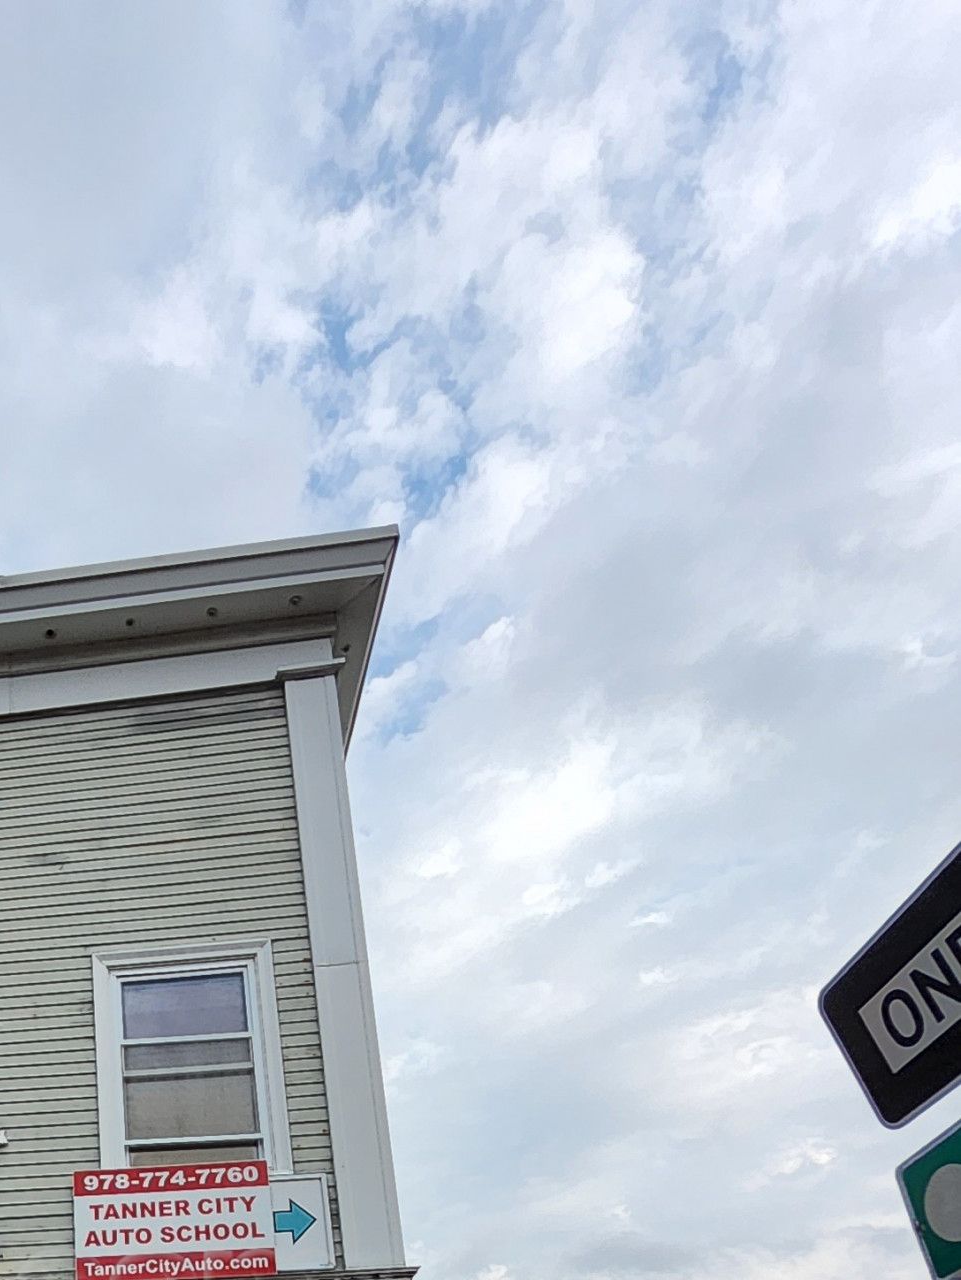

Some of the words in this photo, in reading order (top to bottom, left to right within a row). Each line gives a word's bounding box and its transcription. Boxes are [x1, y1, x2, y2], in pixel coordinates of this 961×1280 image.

[83, 1165, 259, 1191] 978-774-7760
[89, 1199, 191, 1220] TANNER
[197, 1196, 256, 1215] CITY
[84, 1227, 153, 1247] AUTO
[160, 1222, 265, 1242] SCHOOL
[84, 1254, 269, 1278] TannerCityAuto.com
